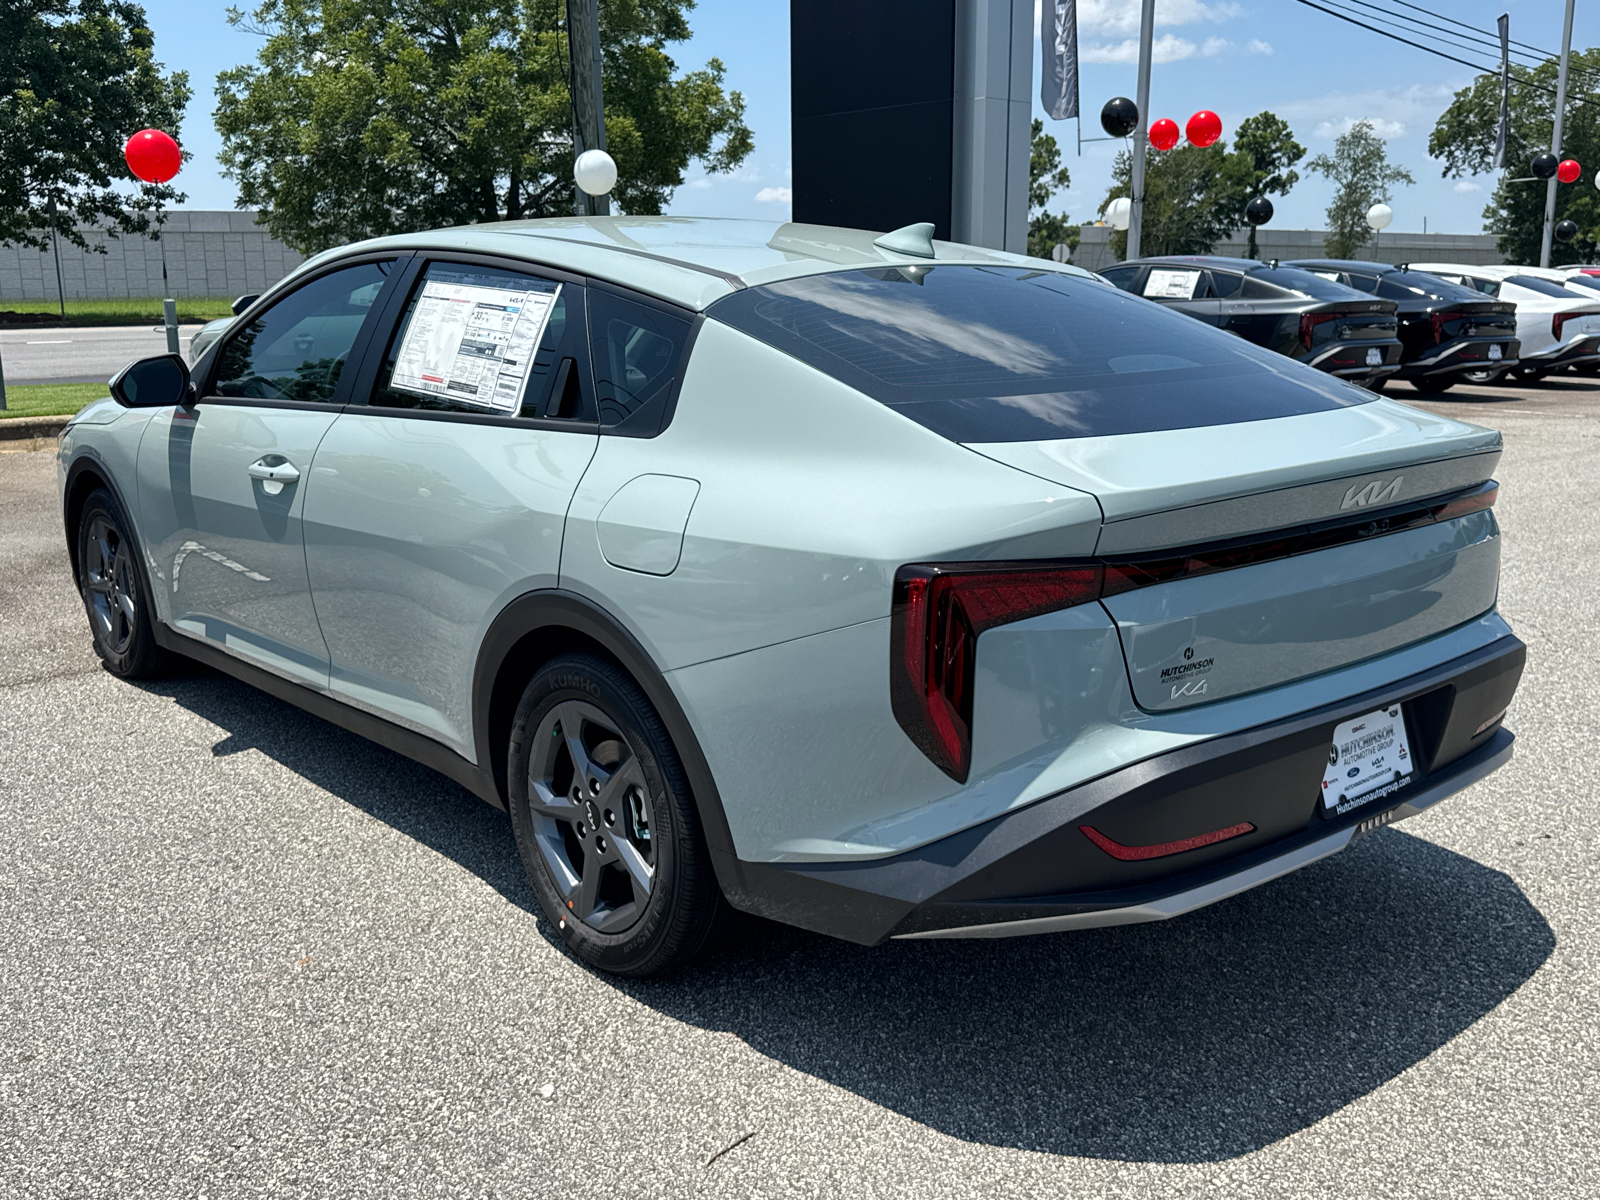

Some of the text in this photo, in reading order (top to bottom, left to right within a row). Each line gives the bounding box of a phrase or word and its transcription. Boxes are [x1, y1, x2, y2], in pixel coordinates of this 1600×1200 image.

[1160, 657, 1215, 679] HUTCHINSON
[1161, 667, 1212, 684] AUTOMOTIVE GROUP
[549, 673, 601, 699] KUMHO
[1170, 679, 1208, 700] K4
[1351, 723, 1366, 734] GMC
[1340, 724, 1395, 758] HUTCHINSON
[1343, 738, 1394, 766] AUTOMOTIVE GROUP
[1336, 775, 1411, 815] Hutchinsonautogroup.com
